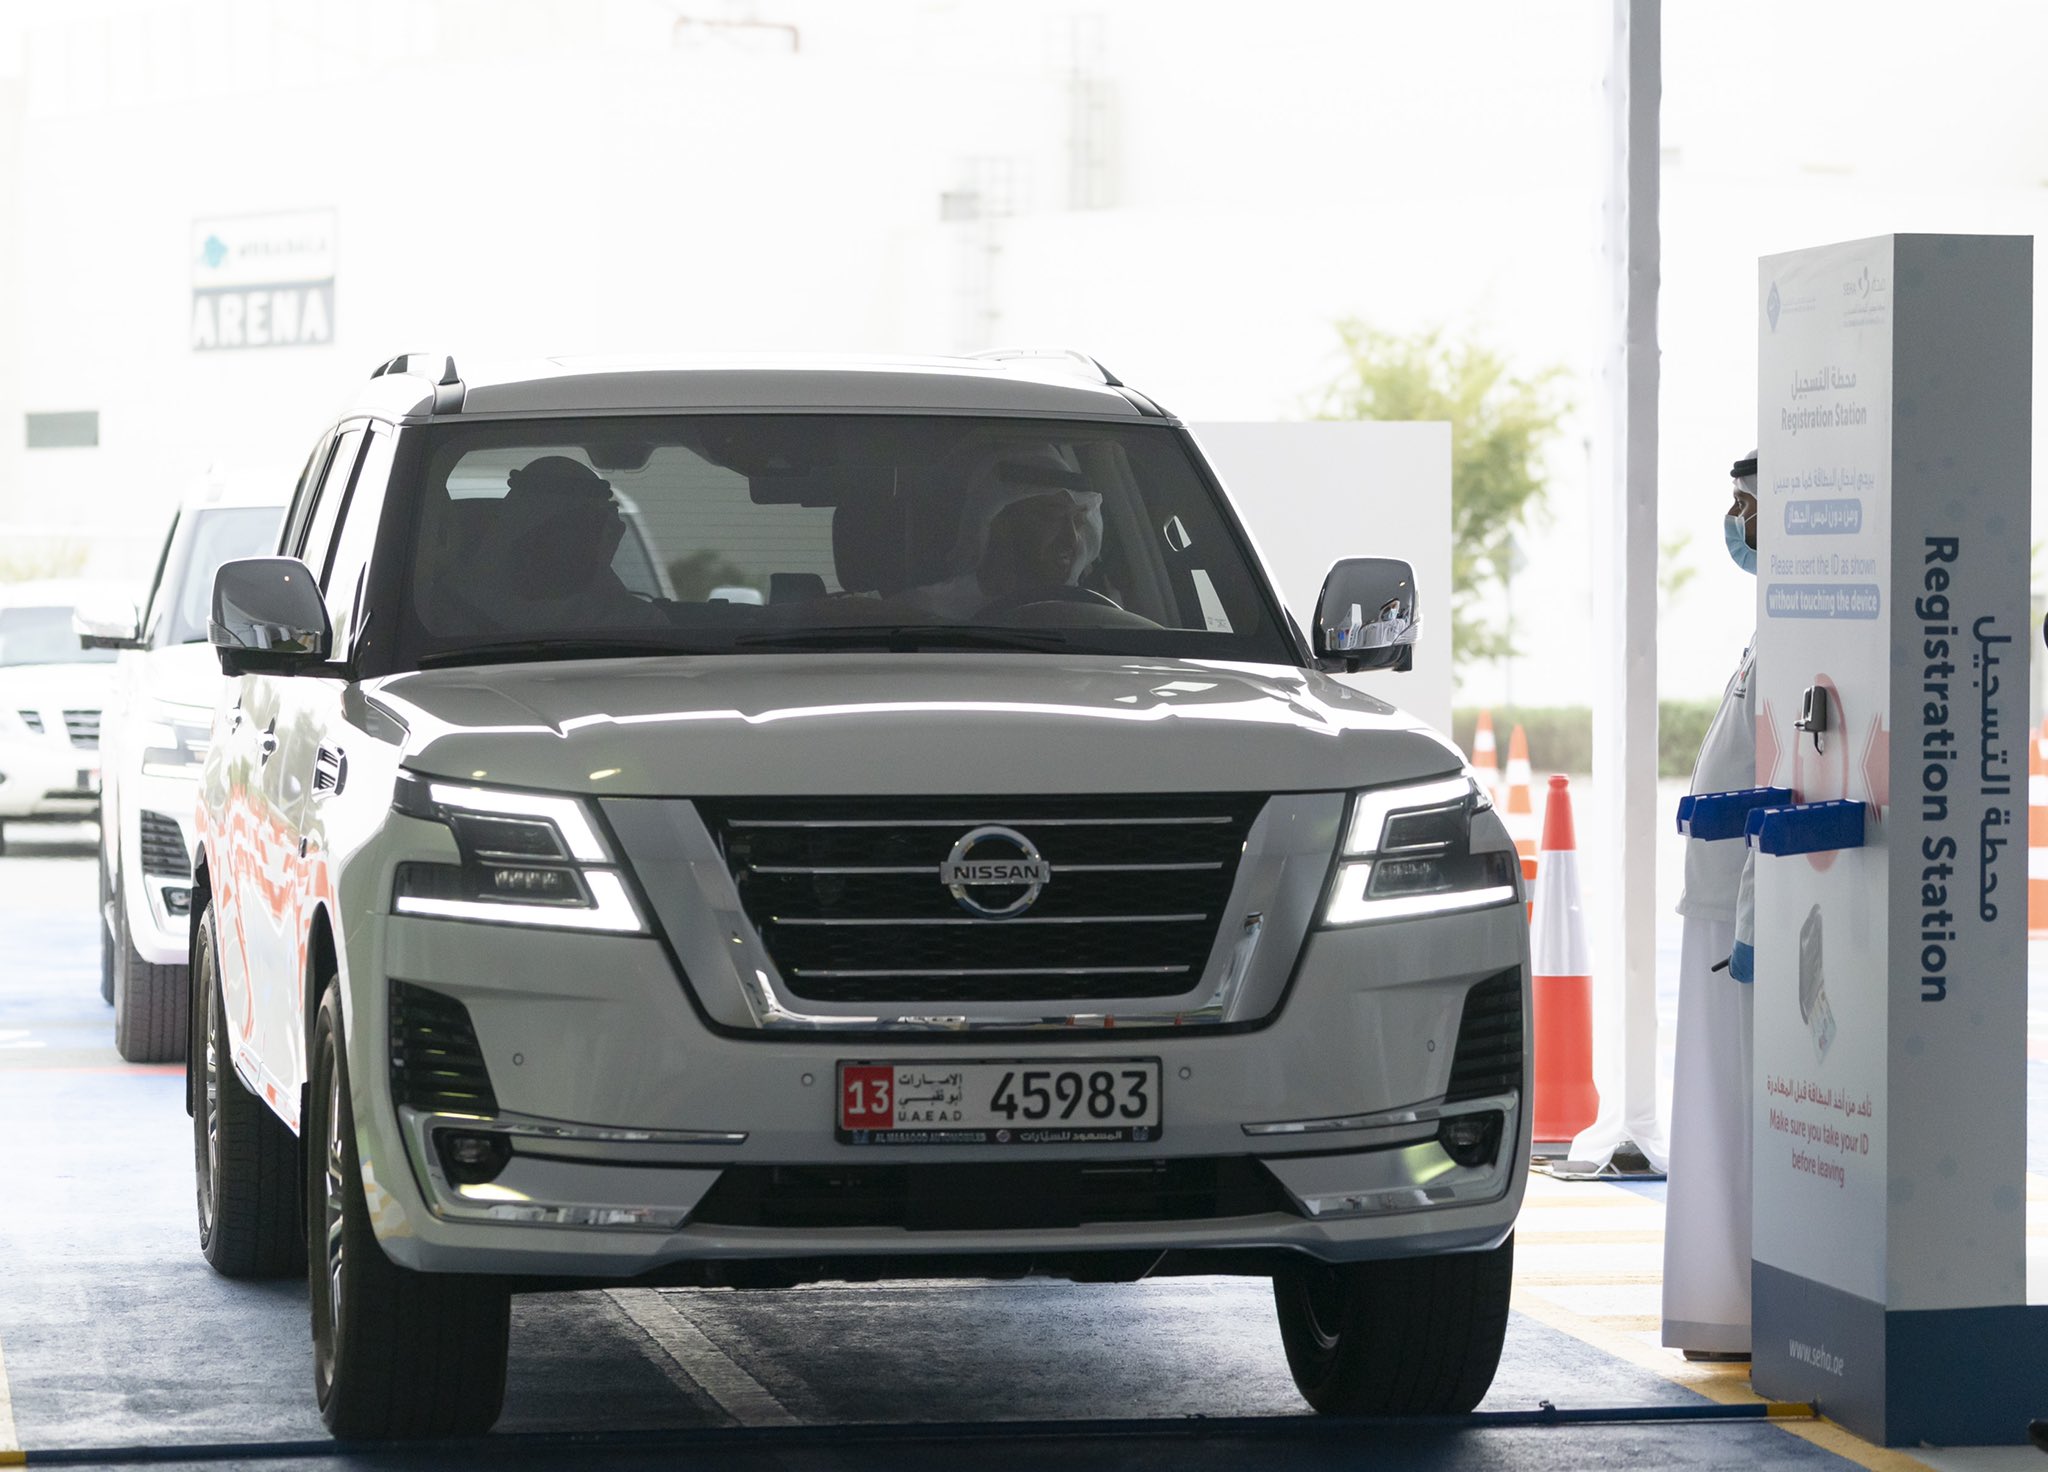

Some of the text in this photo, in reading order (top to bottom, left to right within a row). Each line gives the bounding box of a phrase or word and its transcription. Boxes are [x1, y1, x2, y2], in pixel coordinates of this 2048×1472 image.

[192, 289, 329, 347] ARENA
[1791, 366, 1856, 400] محطة التسجيل
[1781, 402, 1867, 436] Registration Station
[1770, 554, 1876, 575] Please insert the ID as shown
[1769, 589, 1877, 616] without touching the device
[1915, 537, 1960, 1003] Registration Station
[1972, 616, 2012, 923] محطة التسجيل
[953, 866, 1040, 879] NISSAN
[847, 1080, 890, 1115] 13
[989, 1070, 1149, 1120] 45983
[1767, 1075, 1793, 1097] المغادرة
[1794, 1080, 1807, 1104] قبل
[1808, 1082, 1832, 1110] البطاقة
[1845, 1096, 1856, 1117] من
[1857, 1091, 1872, 1117] تأكد
[1020, 1130, 1122, 1143] المسعود للسيارات
[1769, 1107, 1869, 1155] Make sure you take your ID
[1791, 1147, 1845, 1188] before leaving
